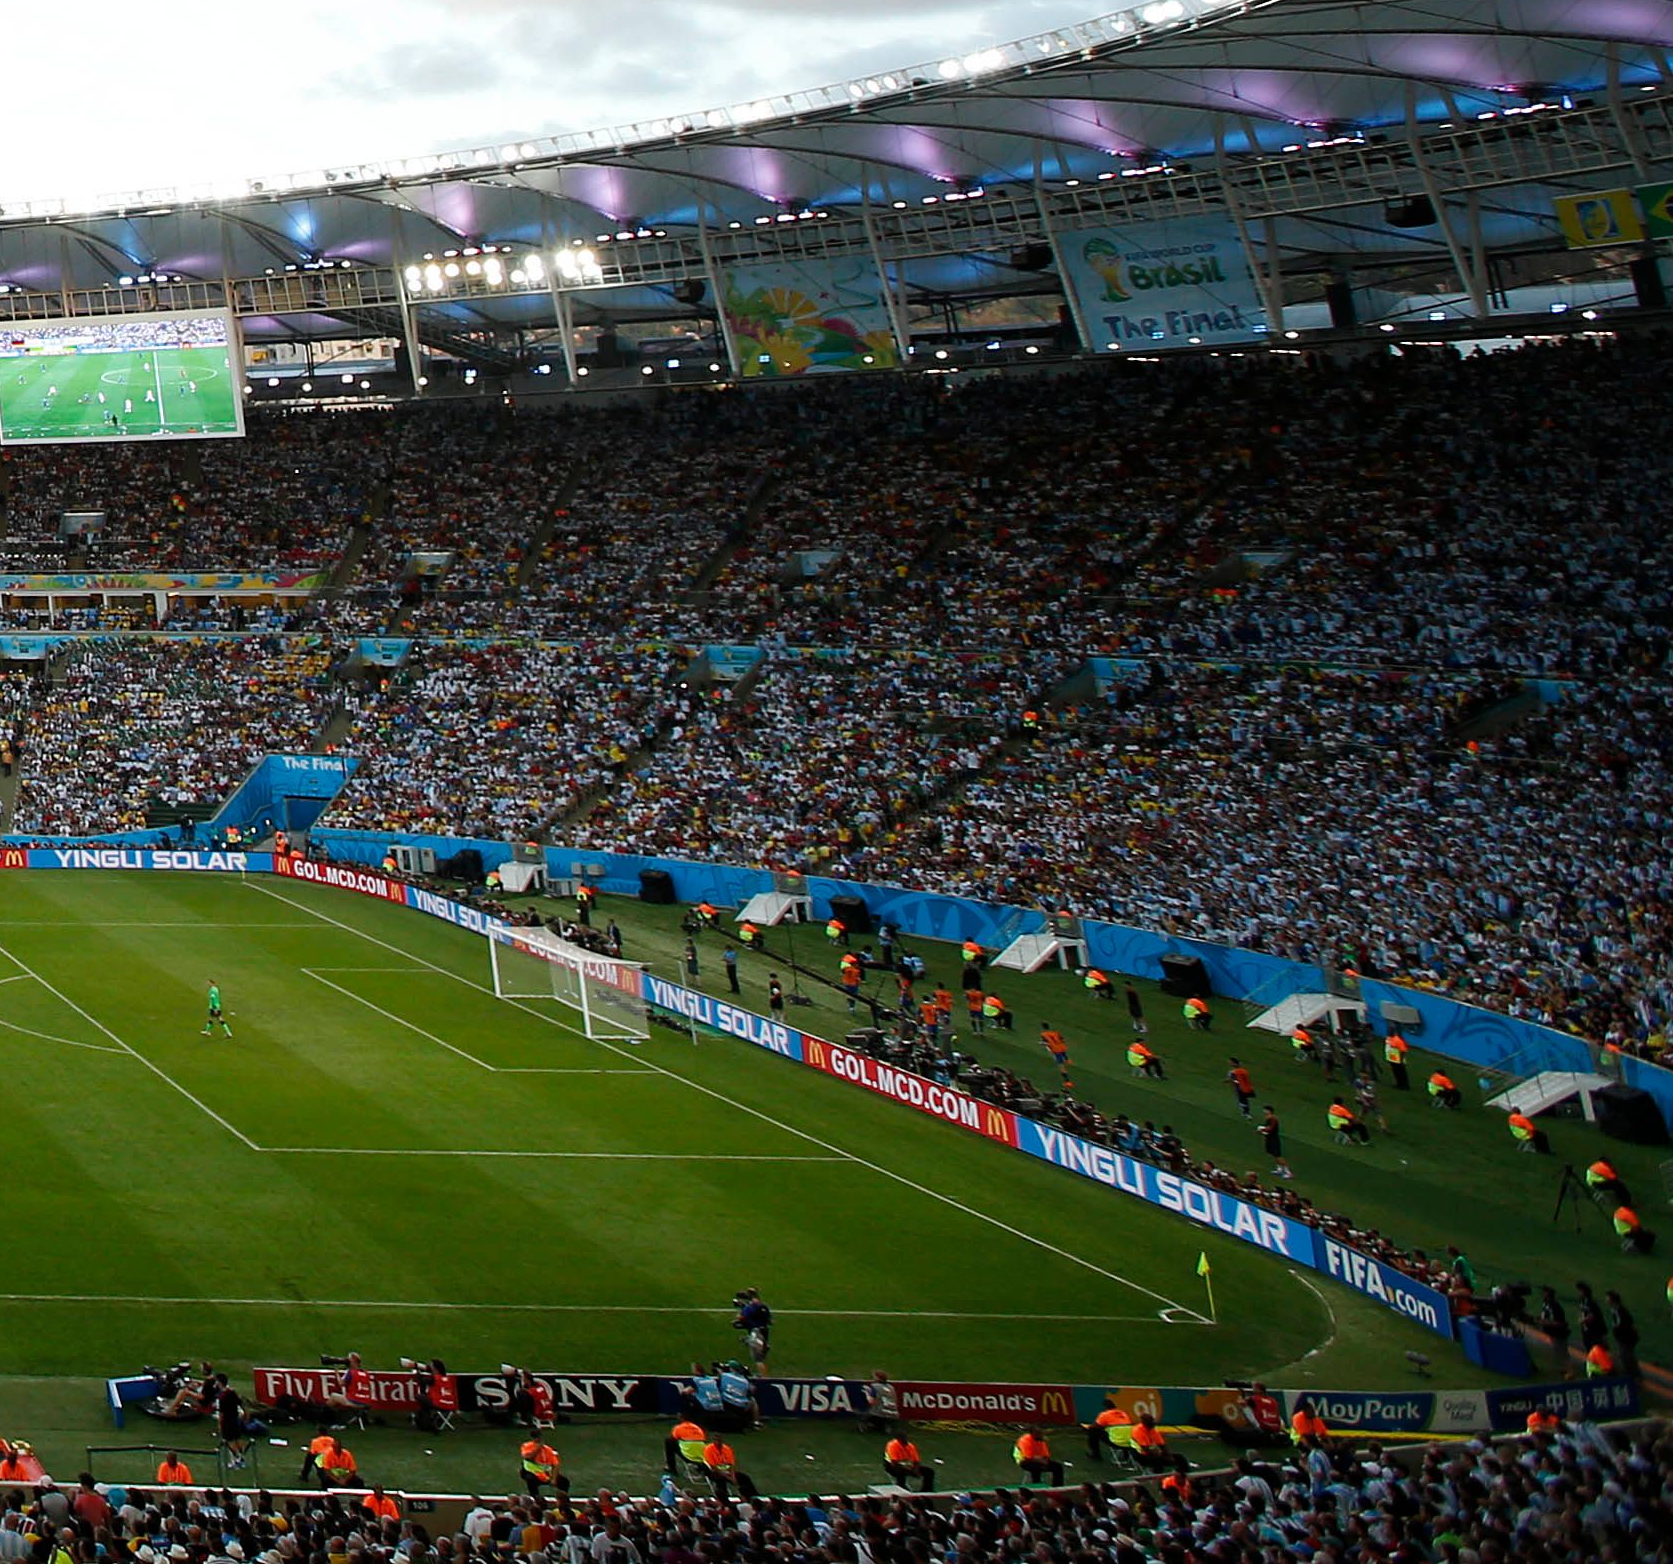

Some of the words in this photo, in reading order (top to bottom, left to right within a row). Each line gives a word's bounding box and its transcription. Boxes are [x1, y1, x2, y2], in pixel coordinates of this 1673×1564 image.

[1103, 315, 1159, 339] The
[1165, 305, 1246, 337] Final
[282, 756, 309, 770] The
[55, 849, 142, 869] YINGLI
[152, 850, 245, 870] SOLAR
[293, 860, 388, 897] GOL.MCD.COM
[416, 891, 455, 924] YINGLI
[649, 977, 711, 1023] YINGLI
[717, 1002, 790, 1056] SOLAR
[830, 1048, 980, 1130] GOL.MCD.COM
[1034, 1123, 1147, 1199] YINGLI
[1154, 1169, 1292, 1256] SOLAR
[265, 1372, 314, 1402] Fly
[320, 1374, 430, 1403] Eirat
[770, 1384, 853, 1414] VISA
[902, 1392, 1038, 1412] McDonald's
[1307, 1397, 1422, 1424] MoyPark
